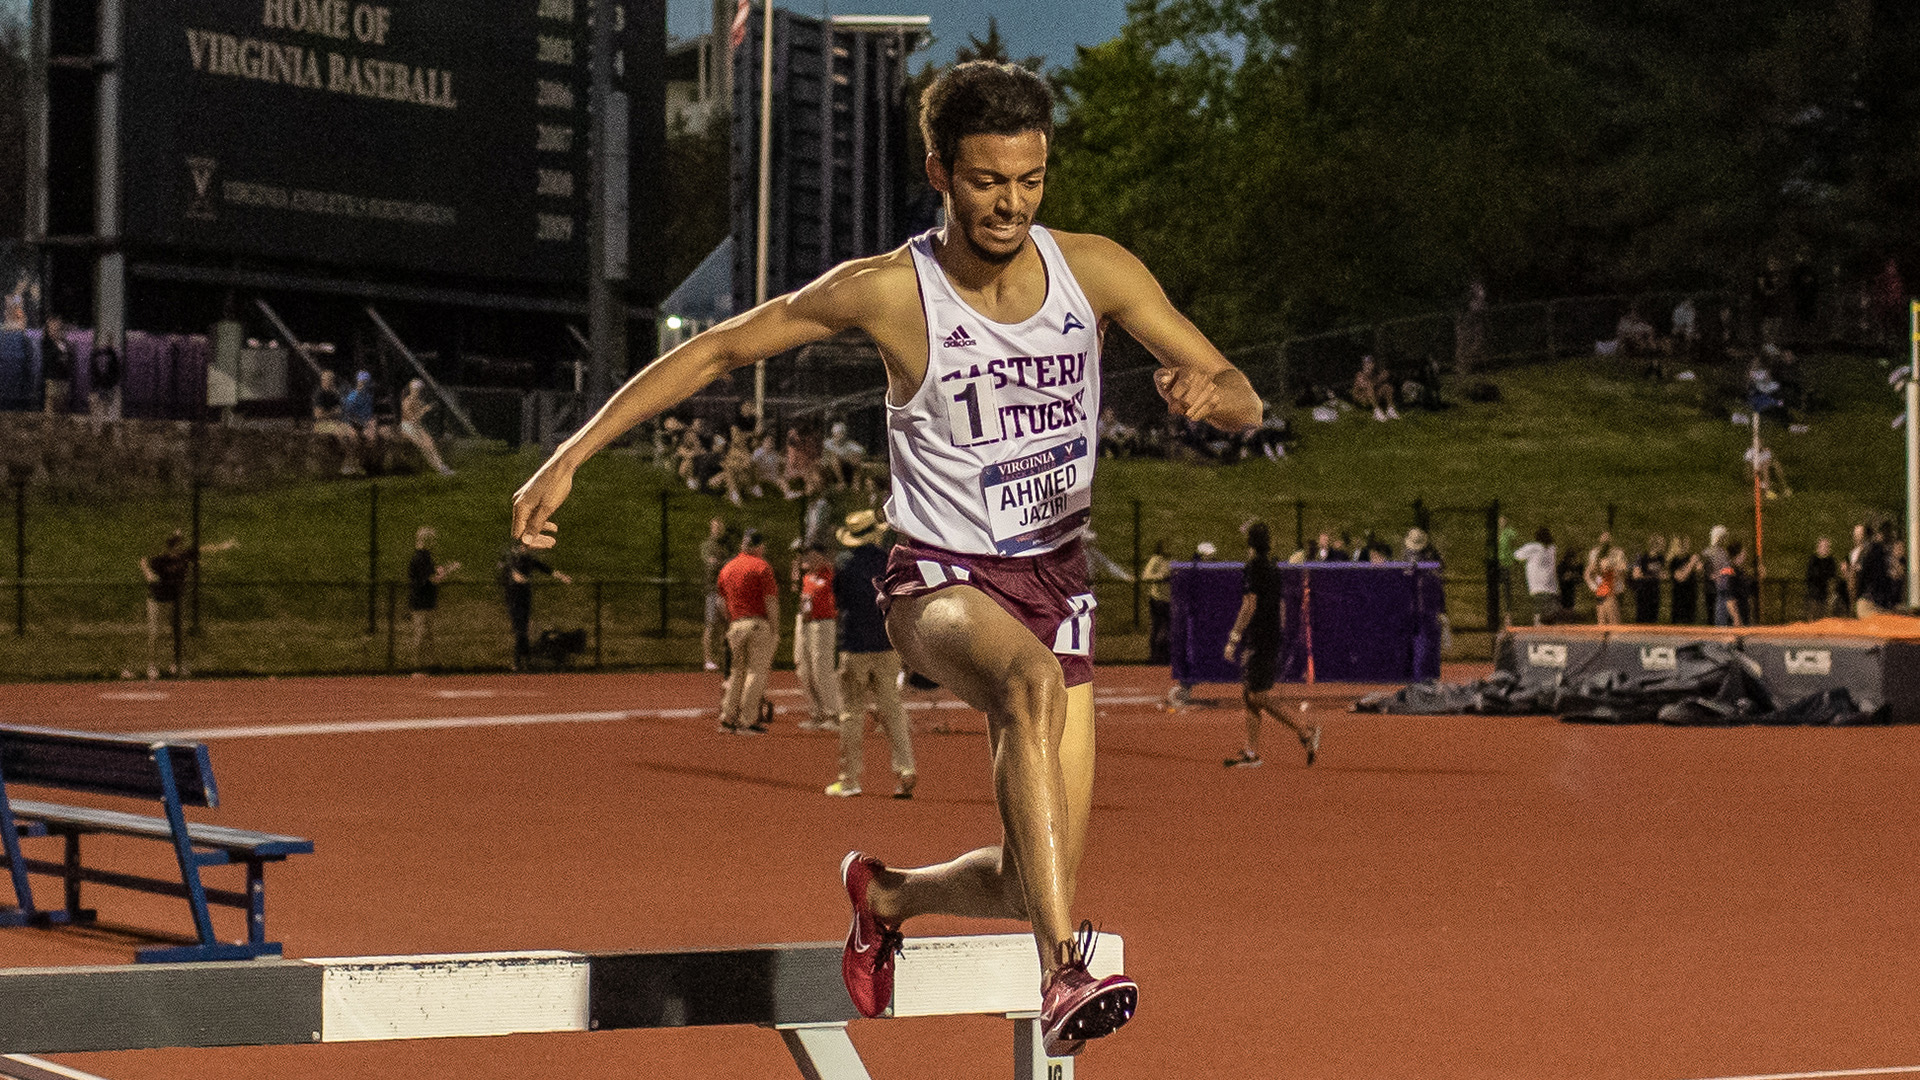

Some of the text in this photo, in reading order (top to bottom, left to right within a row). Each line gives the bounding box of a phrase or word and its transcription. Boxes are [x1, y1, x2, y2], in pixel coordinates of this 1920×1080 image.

[262, 0, 391, 45] HOME OF
[186, 28, 458, 109] VIRGINIA BASEBALL
[943, 338, 977, 348] adidas
[941, 351, 1088, 390] STERN
[953, 382, 983, 440] 1
[998, 451, 1055, 475] VIRGINIA
[1000, 463, 1077, 511] AHMED
[1019, 493, 1068, 527] JAZIRI
